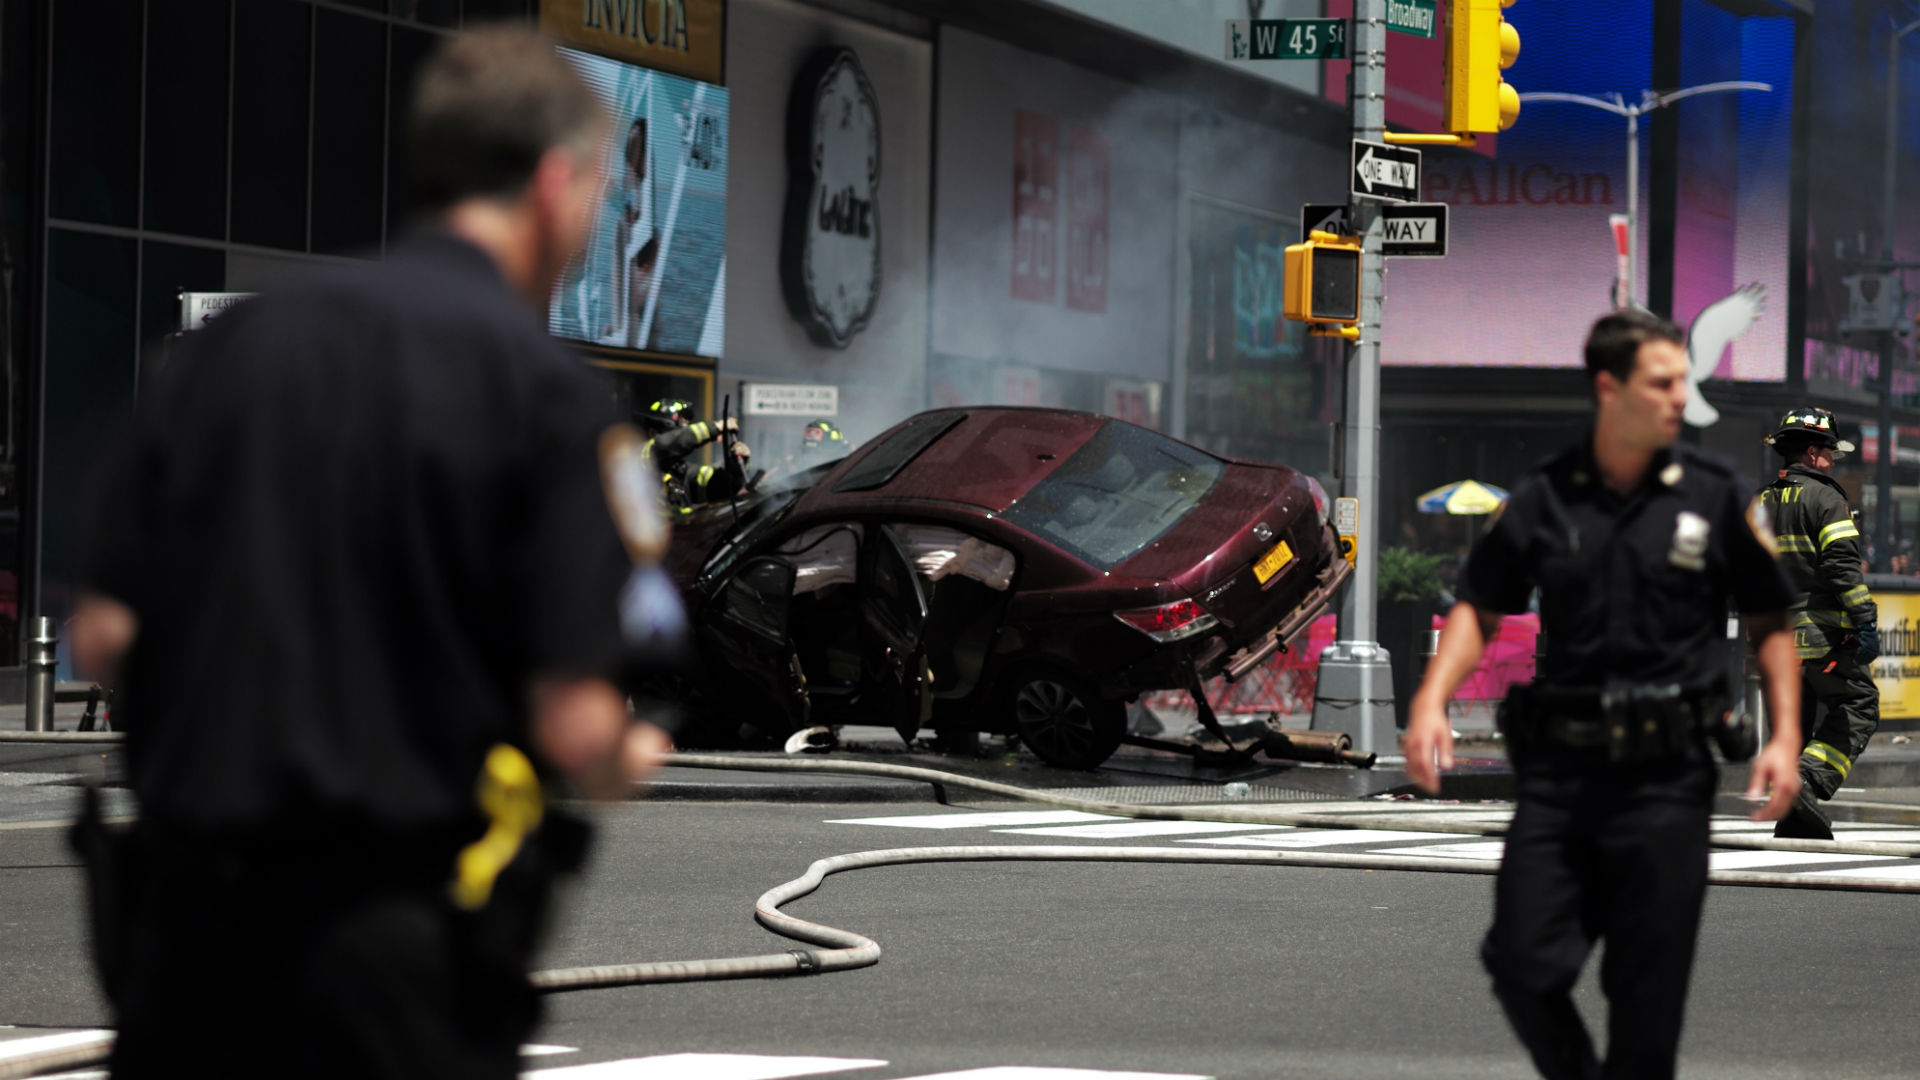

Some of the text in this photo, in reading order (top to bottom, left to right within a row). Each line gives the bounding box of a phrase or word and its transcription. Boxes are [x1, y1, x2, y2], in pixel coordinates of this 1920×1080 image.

[1387, 0, 1434, 38] Broadway
[1256, 24, 1343, 55] W 45 St
[1364, 159, 1411, 187] ONE WAY
[1424, 160, 1613, 206] eAllCan
[1325, 220, 1427, 240] ON WAY
[1760, 486, 1804, 506] FNY
